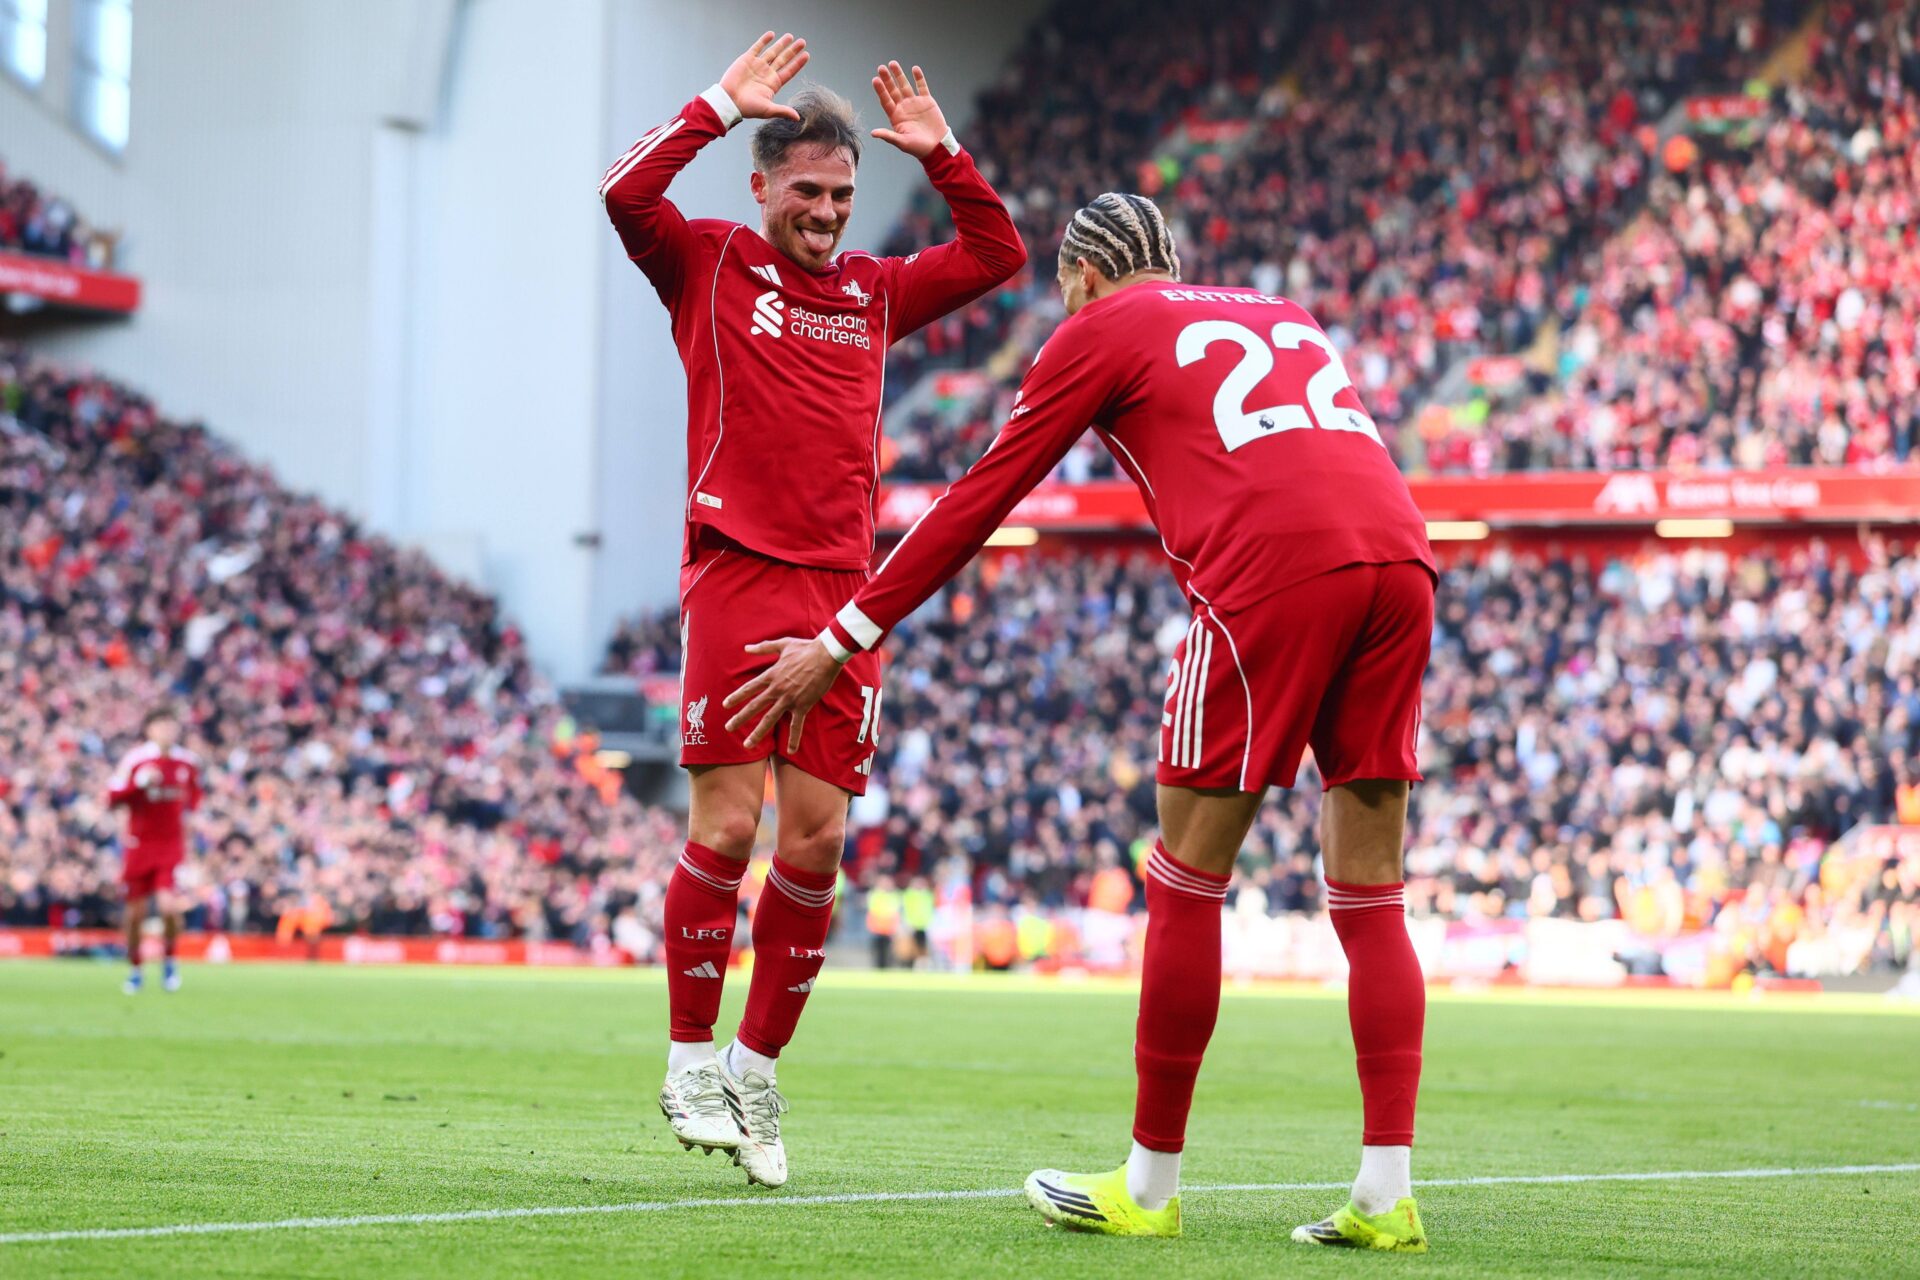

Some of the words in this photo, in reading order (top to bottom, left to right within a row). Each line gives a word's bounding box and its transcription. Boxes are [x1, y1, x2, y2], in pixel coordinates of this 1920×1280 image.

[790, 306, 867, 333] standard
[791, 321, 870, 350] chartered
[1175, 320, 1386, 453] 22
[682, 926, 726, 940] LFC
